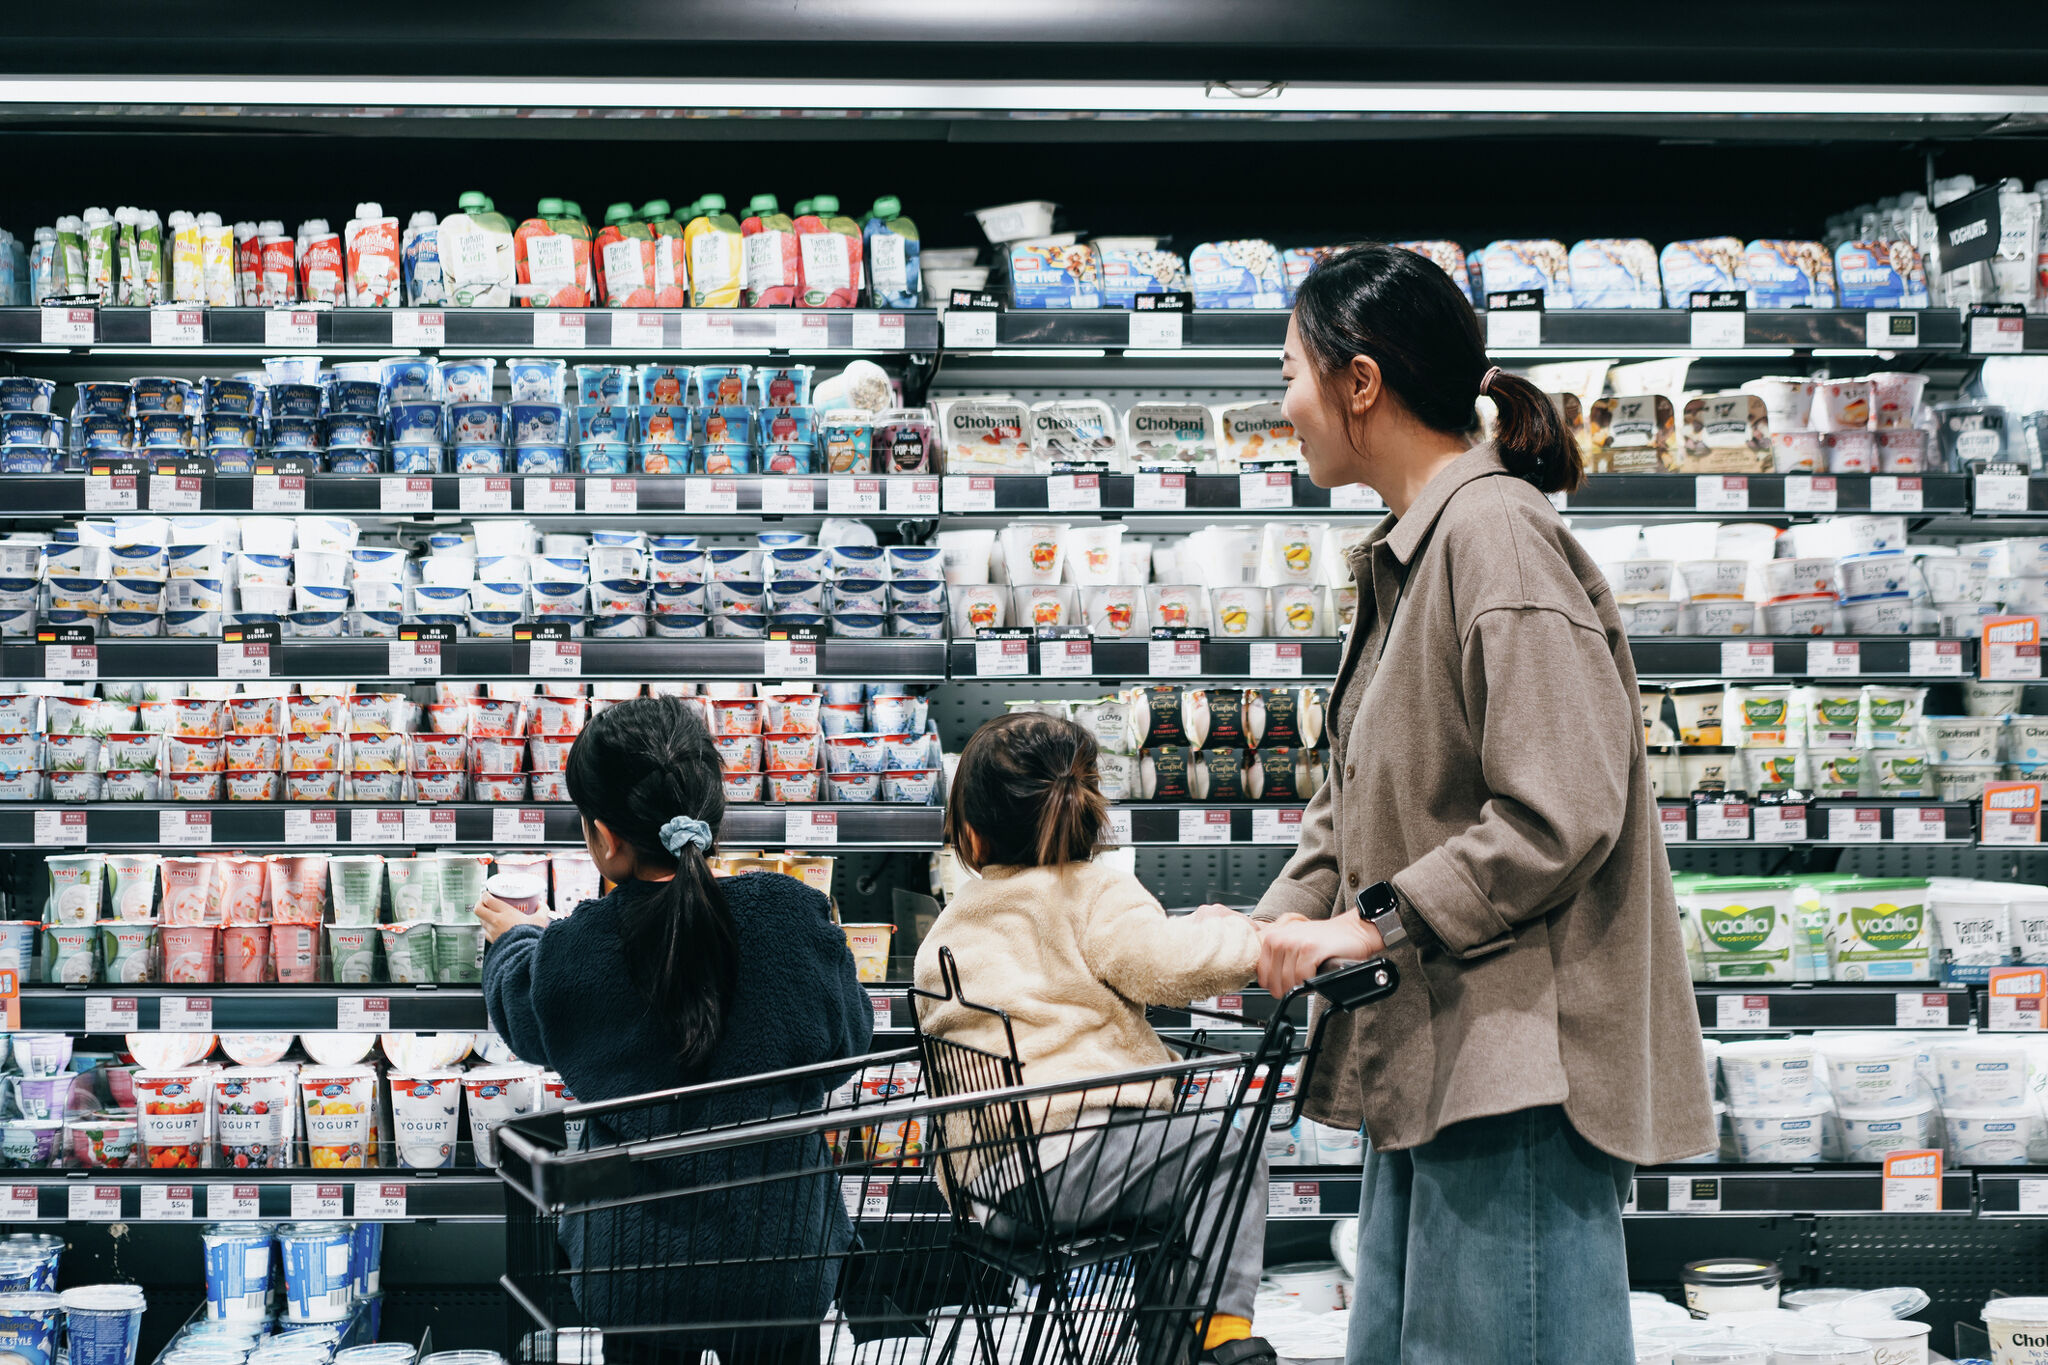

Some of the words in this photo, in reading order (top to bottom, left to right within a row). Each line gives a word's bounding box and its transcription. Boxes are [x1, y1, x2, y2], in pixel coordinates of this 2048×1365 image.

[1949, 218, 1988, 246] YOGHURTS
[953, 416, 1020, 429] Chobani
[1037, 416, 1102, 429] Chobani
[1136, 417, 1204, 431] Chobani
[1098, 714, 1122, 723] CLOVER
[54, 868, 78, 877] meiji
[1707, 916, 1769, 934] vaalia
[1858, 915, 1918, 932] vaalia
[118, 934, 144, 942] meiji
[338, 935, 364, 943] meiji
[853, 936, 878, 944] meiji
[150, 1120, 198, 1129] YOGURT
[312, 1120, 359, 1129] YOGURT
[401, 1122, 448, 1131] YOGURT
[9, 1338, 32, 1346] STYLE
